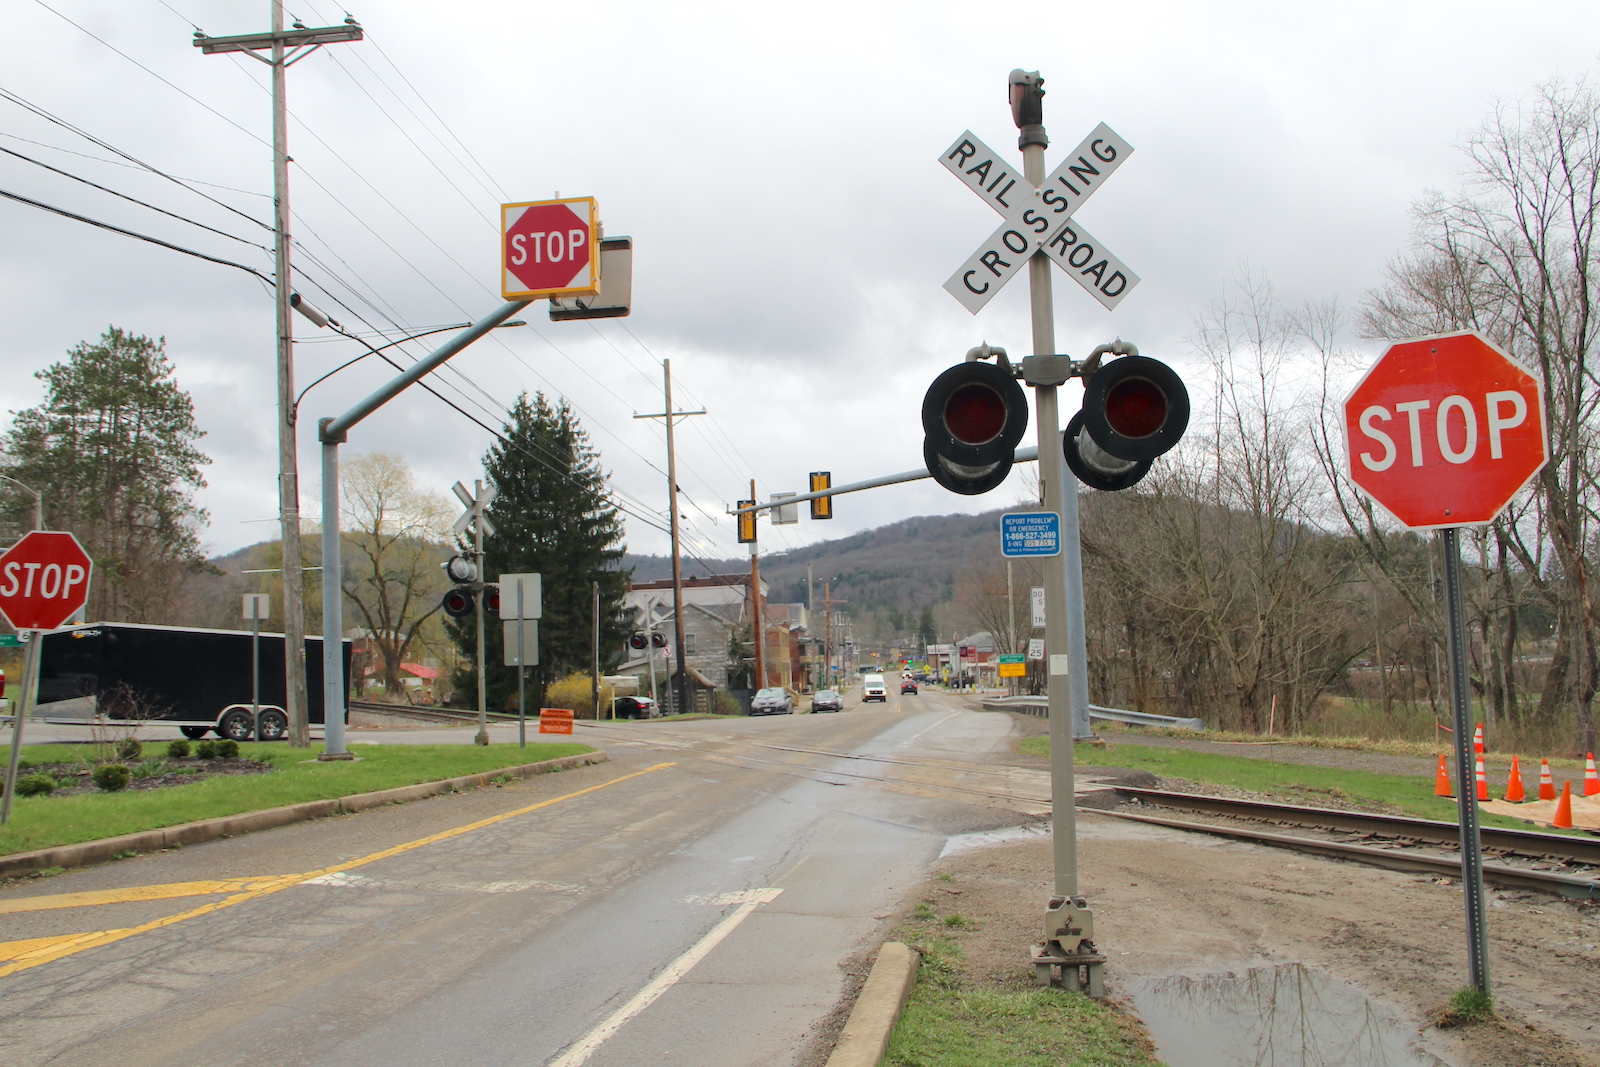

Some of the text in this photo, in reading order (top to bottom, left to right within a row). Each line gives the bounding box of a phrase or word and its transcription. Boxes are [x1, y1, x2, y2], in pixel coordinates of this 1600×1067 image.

[948, 138, 1017, 209] RAIL
[963, 138, 1117, 296] CROSSING
[510, 228, 586, 266] STOP
[1049, 225, 1128, 299] ROAD
[1358, 389, 1528, 472] STOP
[1005, 531, 1056, 540] 1-866-527-3499
[0, 560, 86, 600] STOP
[1030, 649, 1042, 657] 25
